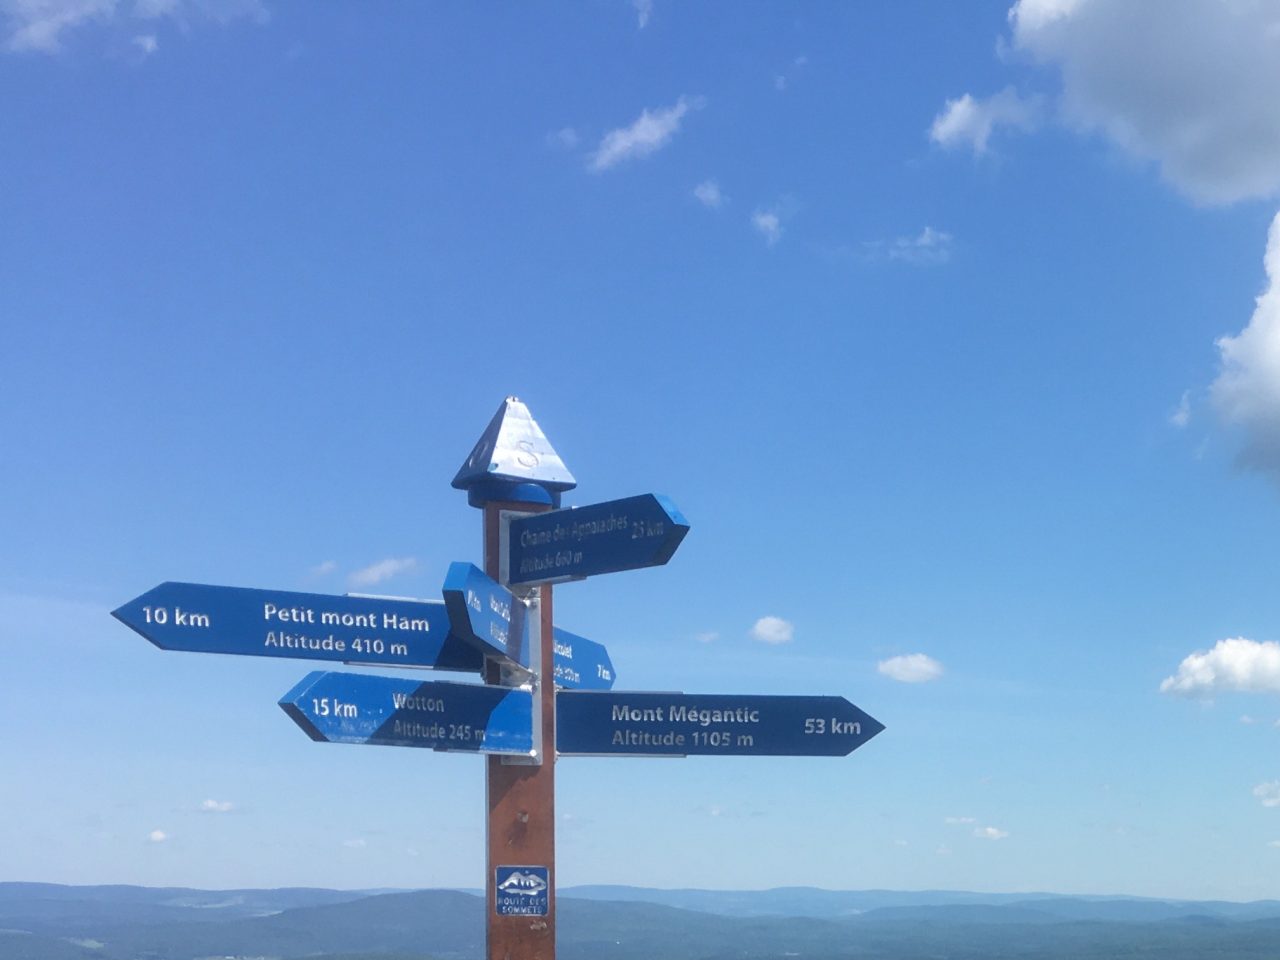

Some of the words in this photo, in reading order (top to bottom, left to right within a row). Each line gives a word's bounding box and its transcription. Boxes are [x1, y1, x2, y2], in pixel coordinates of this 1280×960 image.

[573, 550, 583, 565] m
[142, 605, 168, 626] 10
[174, 606, 210, 628] km
[264, 603, 314, 625] Petit
[320, 608, 377, 629] mont
[382, 612, 430, 633] Ham
[264, 631, 346, 652] Altitude
[351, 638, 385, 655] 410
[390, 643, 408, 656] m
[312, 698, 329, 716] 15
[333, 698, 358, 719] km
[392, 692, 446, 713] Wotton
[611, 704, 664, 723] Mont
[668, 704, 760, 727] Mégantic
[392, 721, 446, 741] Altitude
[448, 723, 471, 741] 245
[473, 728, 487, 742] m
[804, 717, 826, 735] 53
[831, 717, 862, 736] km
[611, 730, 686, 747] Altitude
[691, 731, 731, 747] 1105
[736, 734, 755, 748] m
[502, 905, 543, 914] SOMMETS
